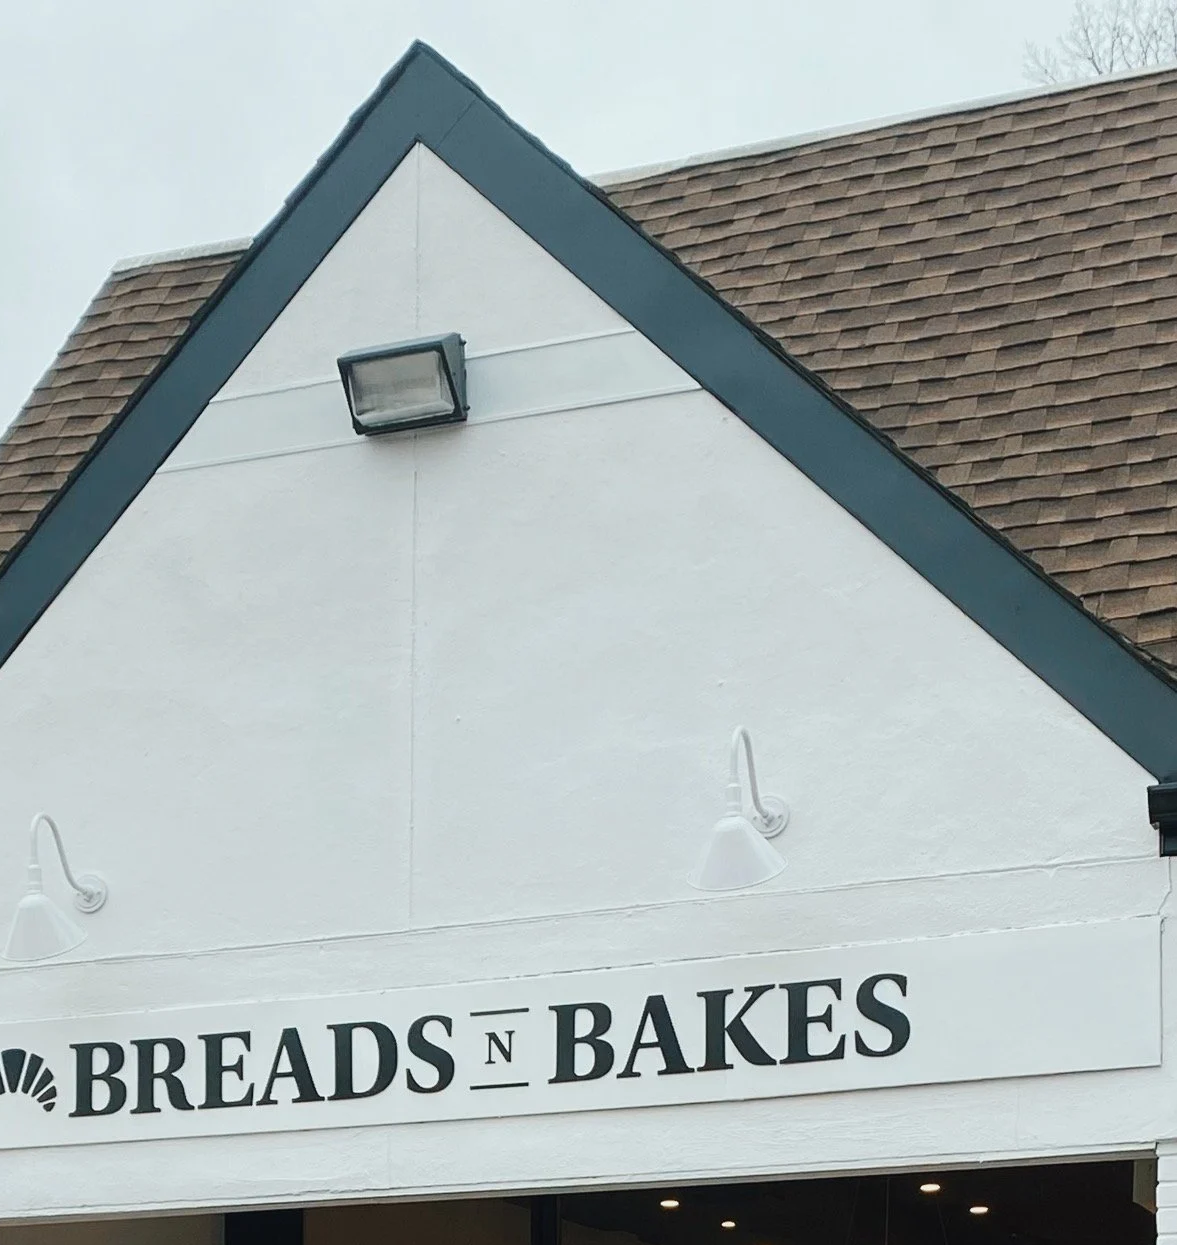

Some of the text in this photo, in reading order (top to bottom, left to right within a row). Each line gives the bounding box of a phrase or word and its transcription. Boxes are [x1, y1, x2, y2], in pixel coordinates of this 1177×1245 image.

[68, 973, 911, 1118] BREADS N BAKES
